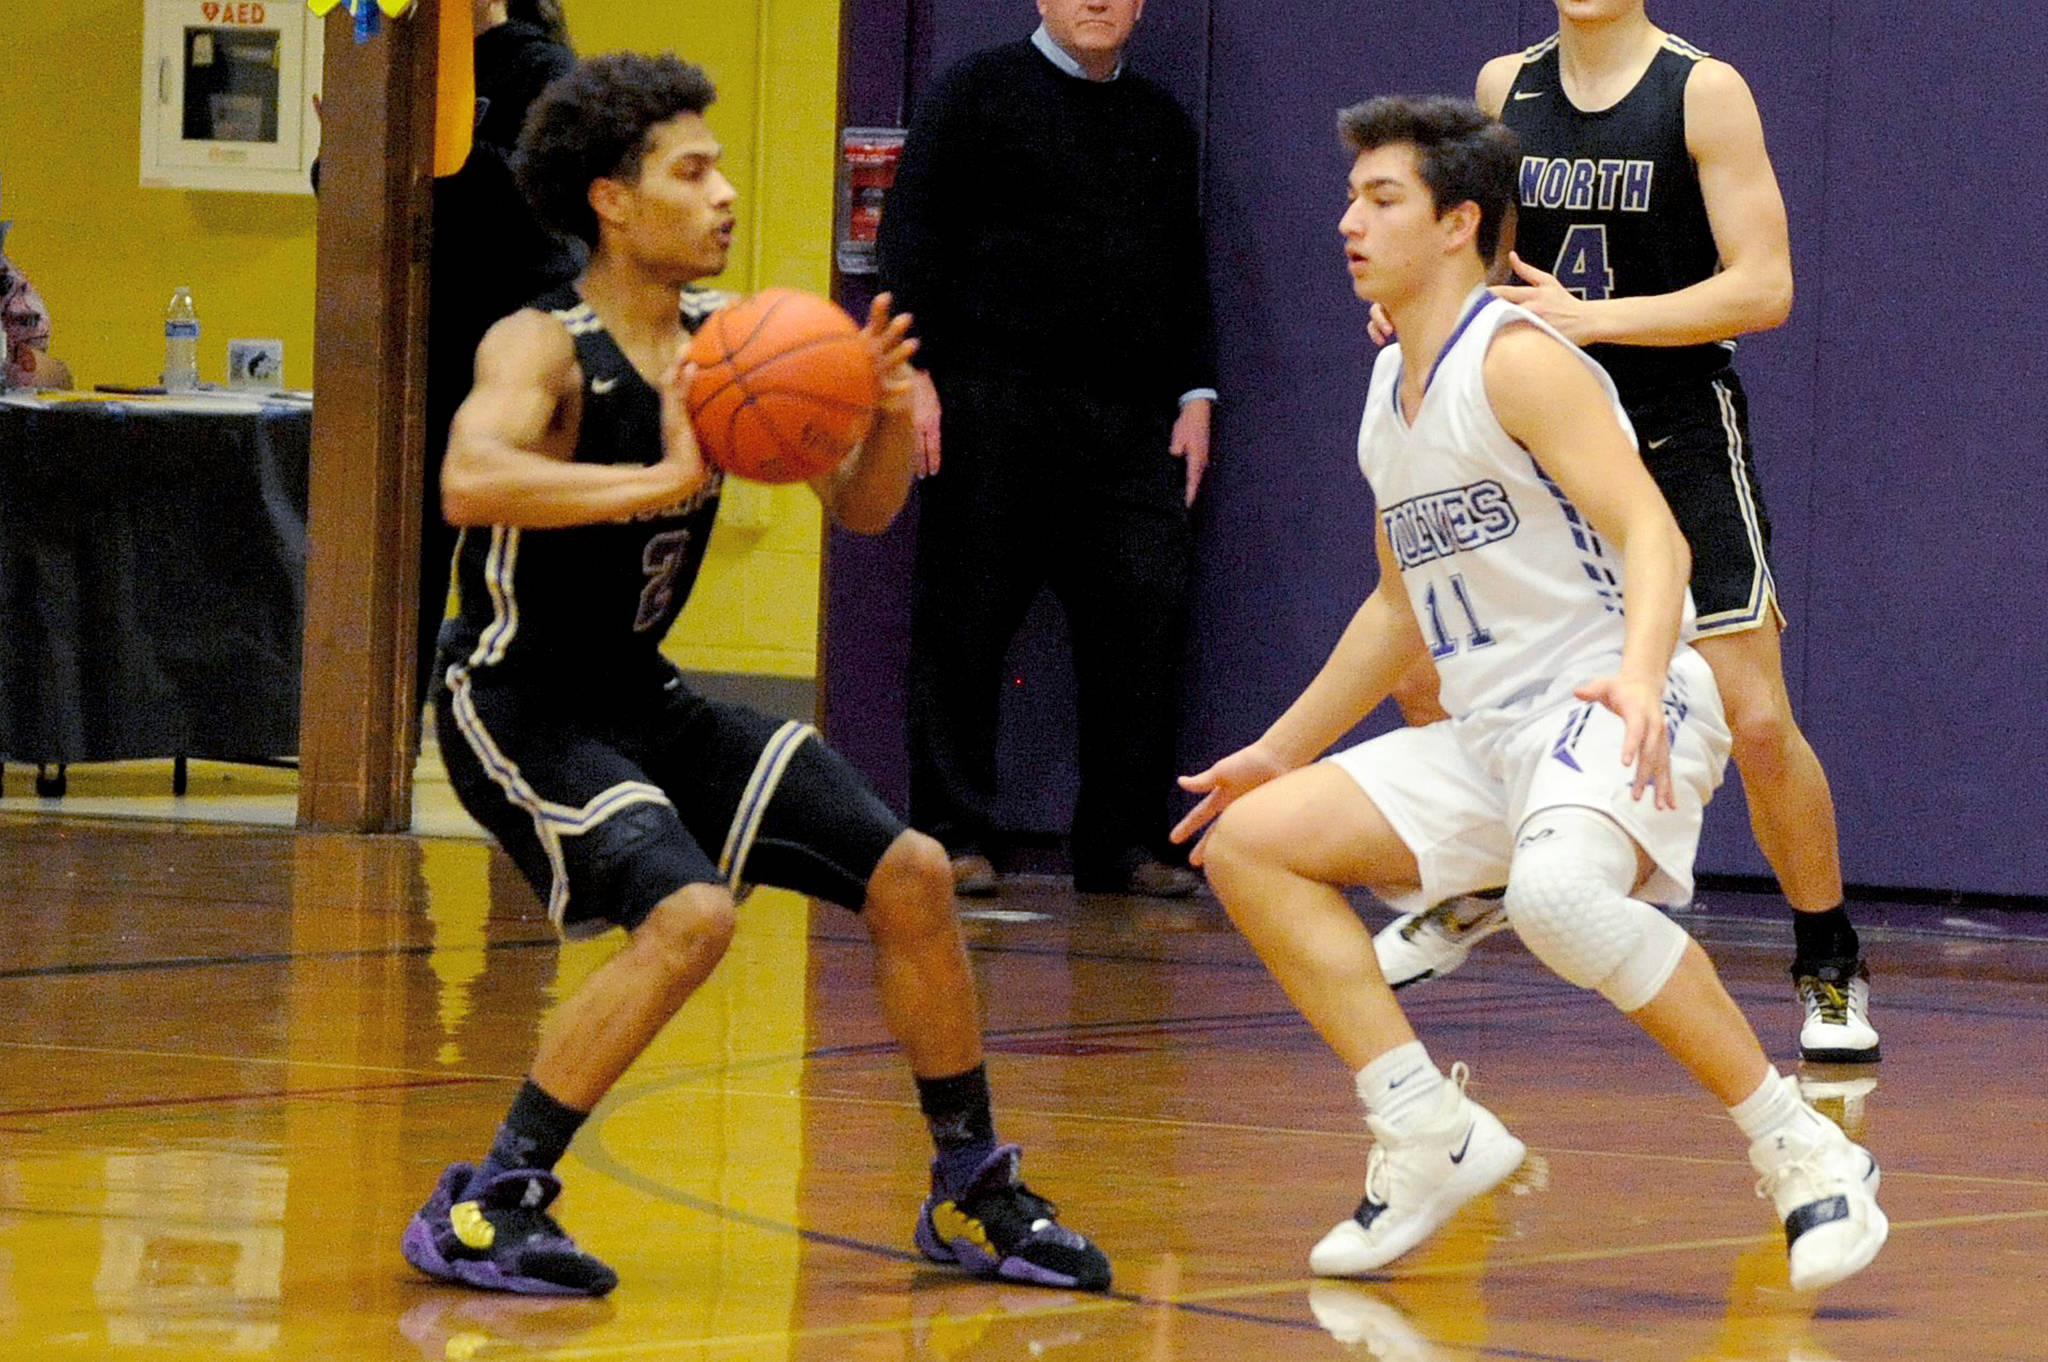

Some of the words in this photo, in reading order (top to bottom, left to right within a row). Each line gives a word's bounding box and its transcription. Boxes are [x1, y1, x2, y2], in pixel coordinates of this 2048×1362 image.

[222, 3, 265, 24] AED
[1519, 156, 1654, 212] NORTH
[1553, 224, 1614, 300] 4
[1425, 573, 1497, 661] 11
